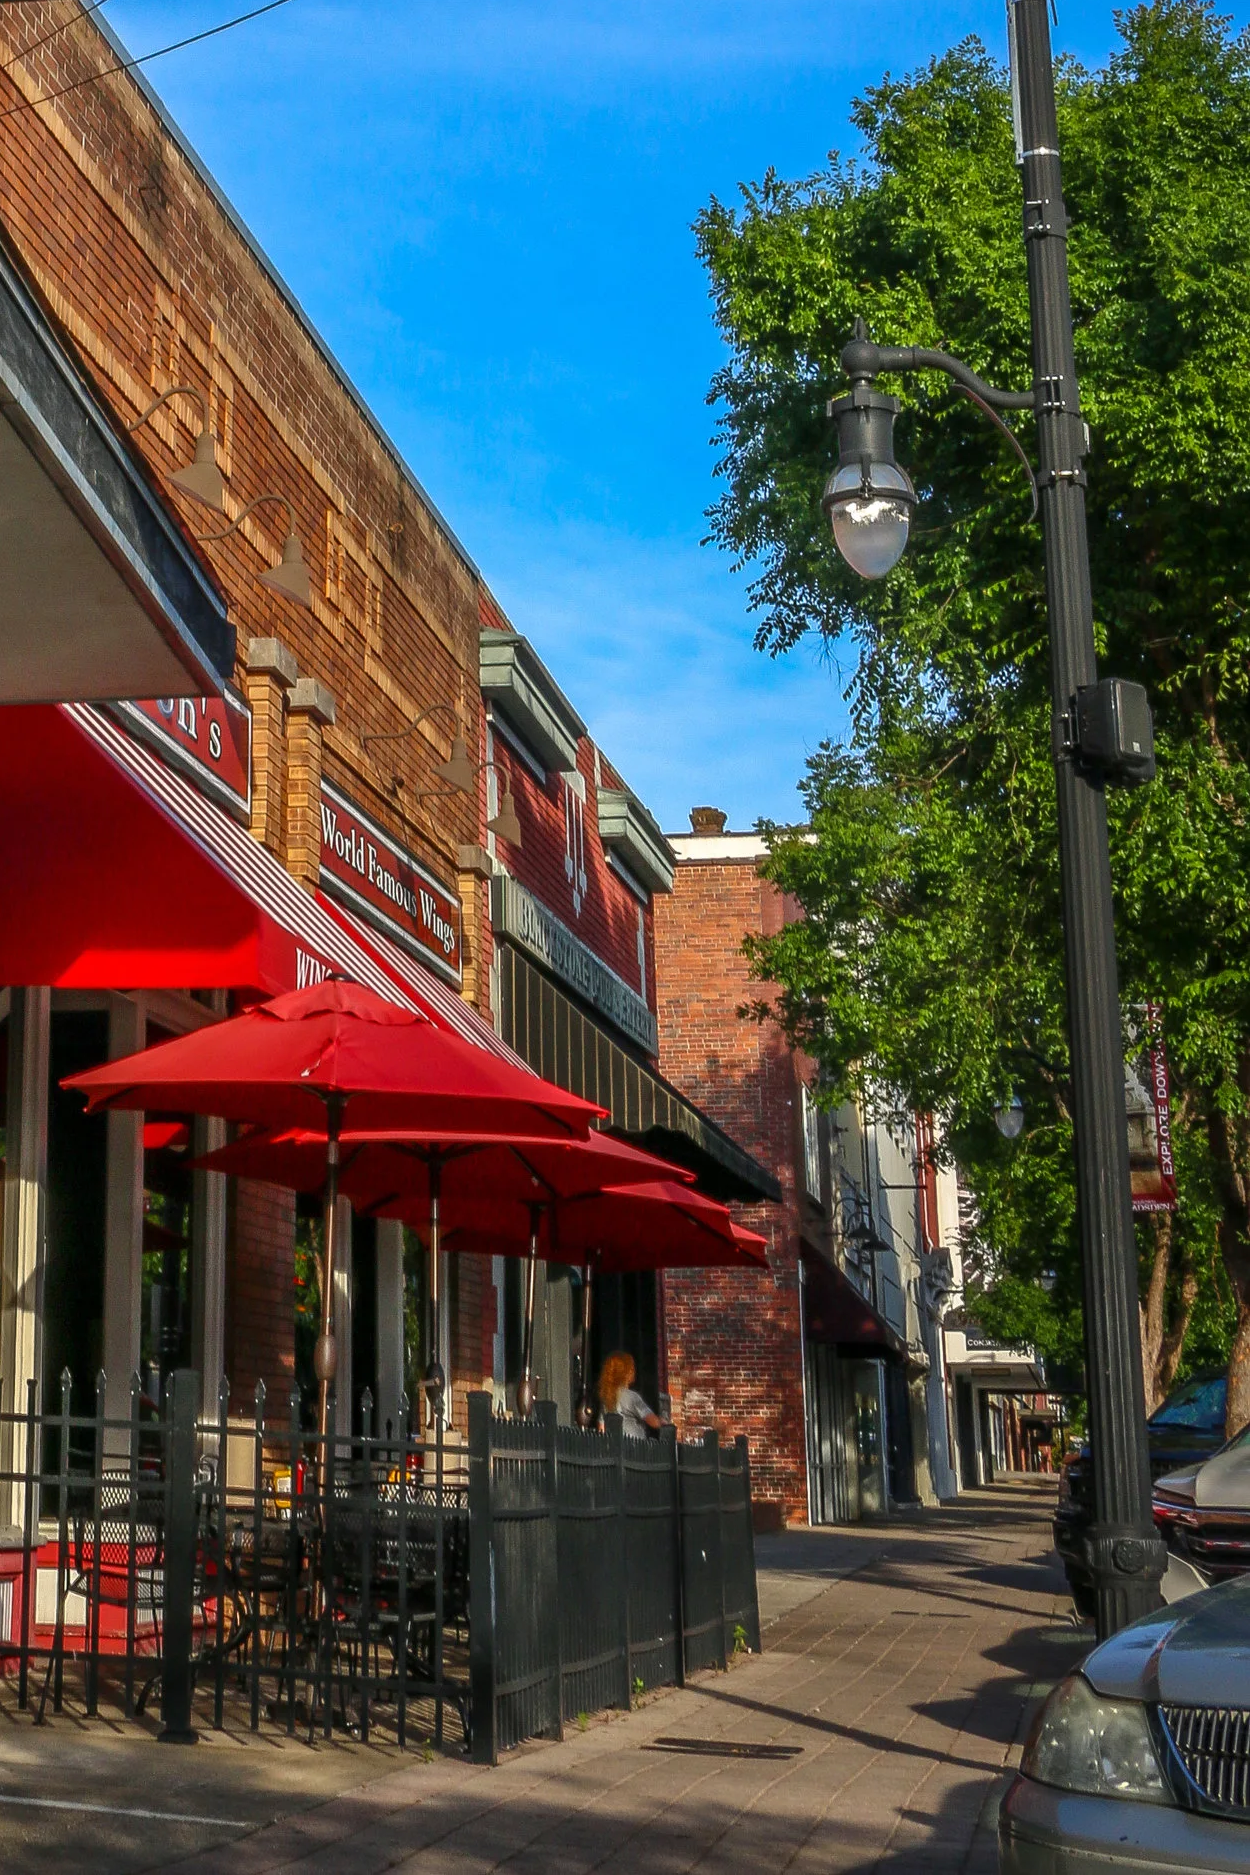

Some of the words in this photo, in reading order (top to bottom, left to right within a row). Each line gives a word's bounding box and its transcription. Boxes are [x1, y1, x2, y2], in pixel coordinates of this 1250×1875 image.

[320, 803, 365, 875] World
[367, 843, 418, 918] Famous
[419, 888, 456, 954] Wings
[296, 947, 332, 991] WIN
